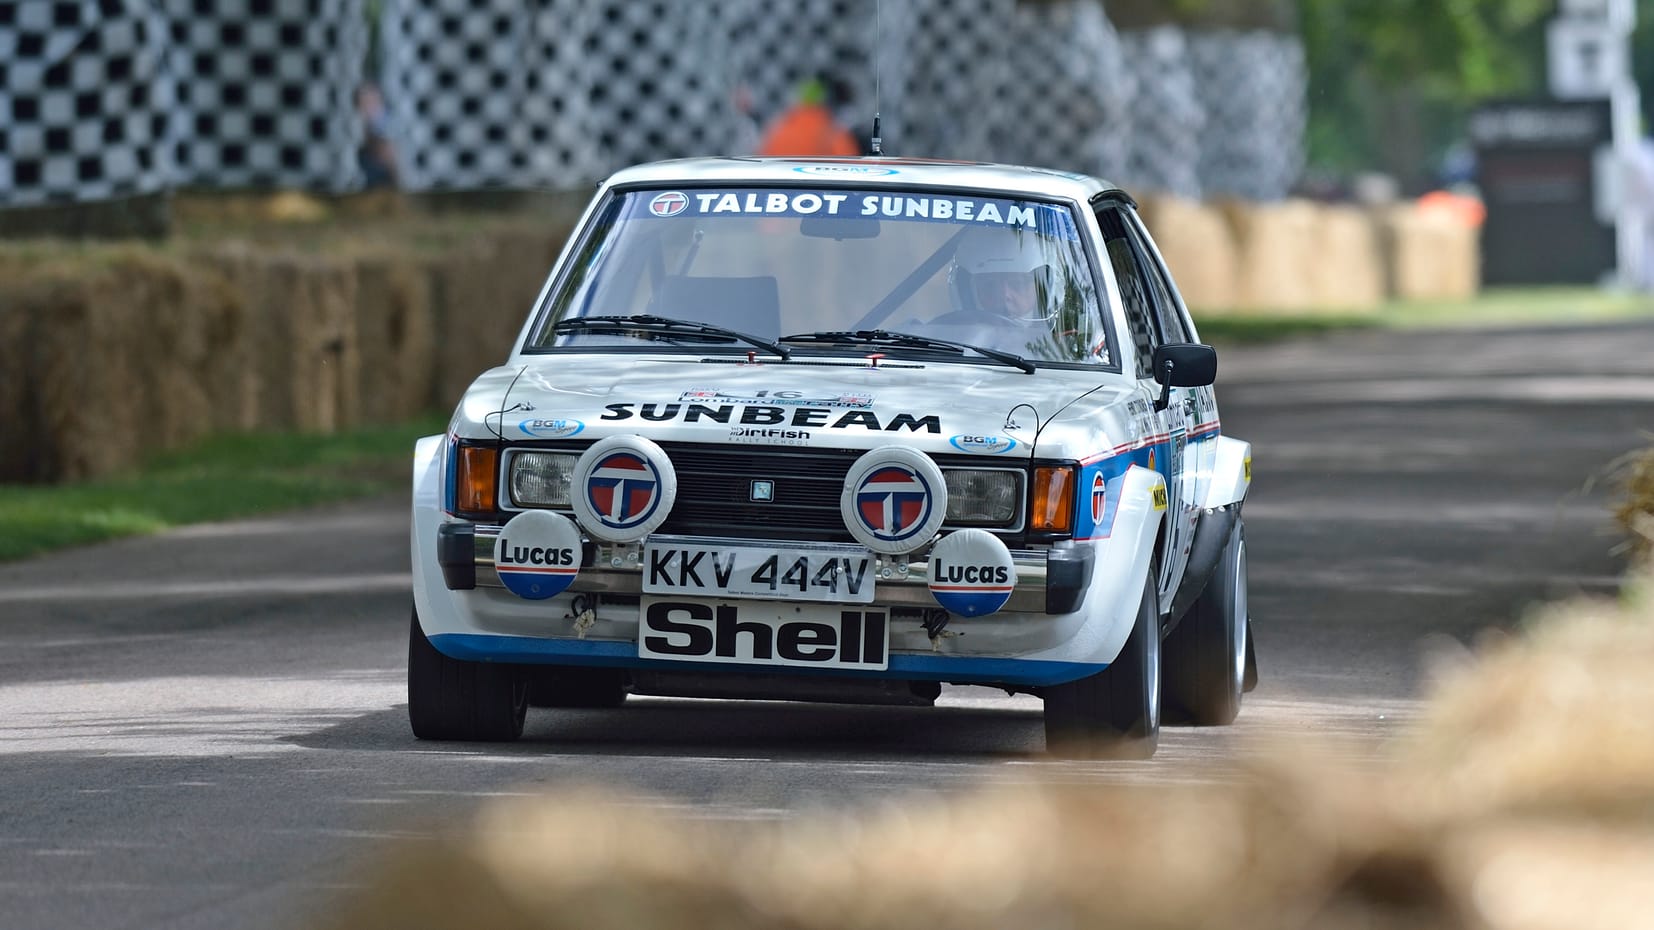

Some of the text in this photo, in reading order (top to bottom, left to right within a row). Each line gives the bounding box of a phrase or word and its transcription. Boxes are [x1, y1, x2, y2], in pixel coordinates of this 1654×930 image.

[695, 193, 848, 215] TALBOT
[861, 195, 1037, 229] SUNBEAM
[755, 390, 803, 399] 16
[532, 419, 567, 428] BGM
[600, 402, 942, 435] SUNBEAM
[963, 435, 998, 445] BGM
[499, 538, 574, 566] Lucas
[649, 548, 869, 596] KKV 444V
[934, 557, 1009, 584] Lucas
[644, 601, 886, 665] Shell
